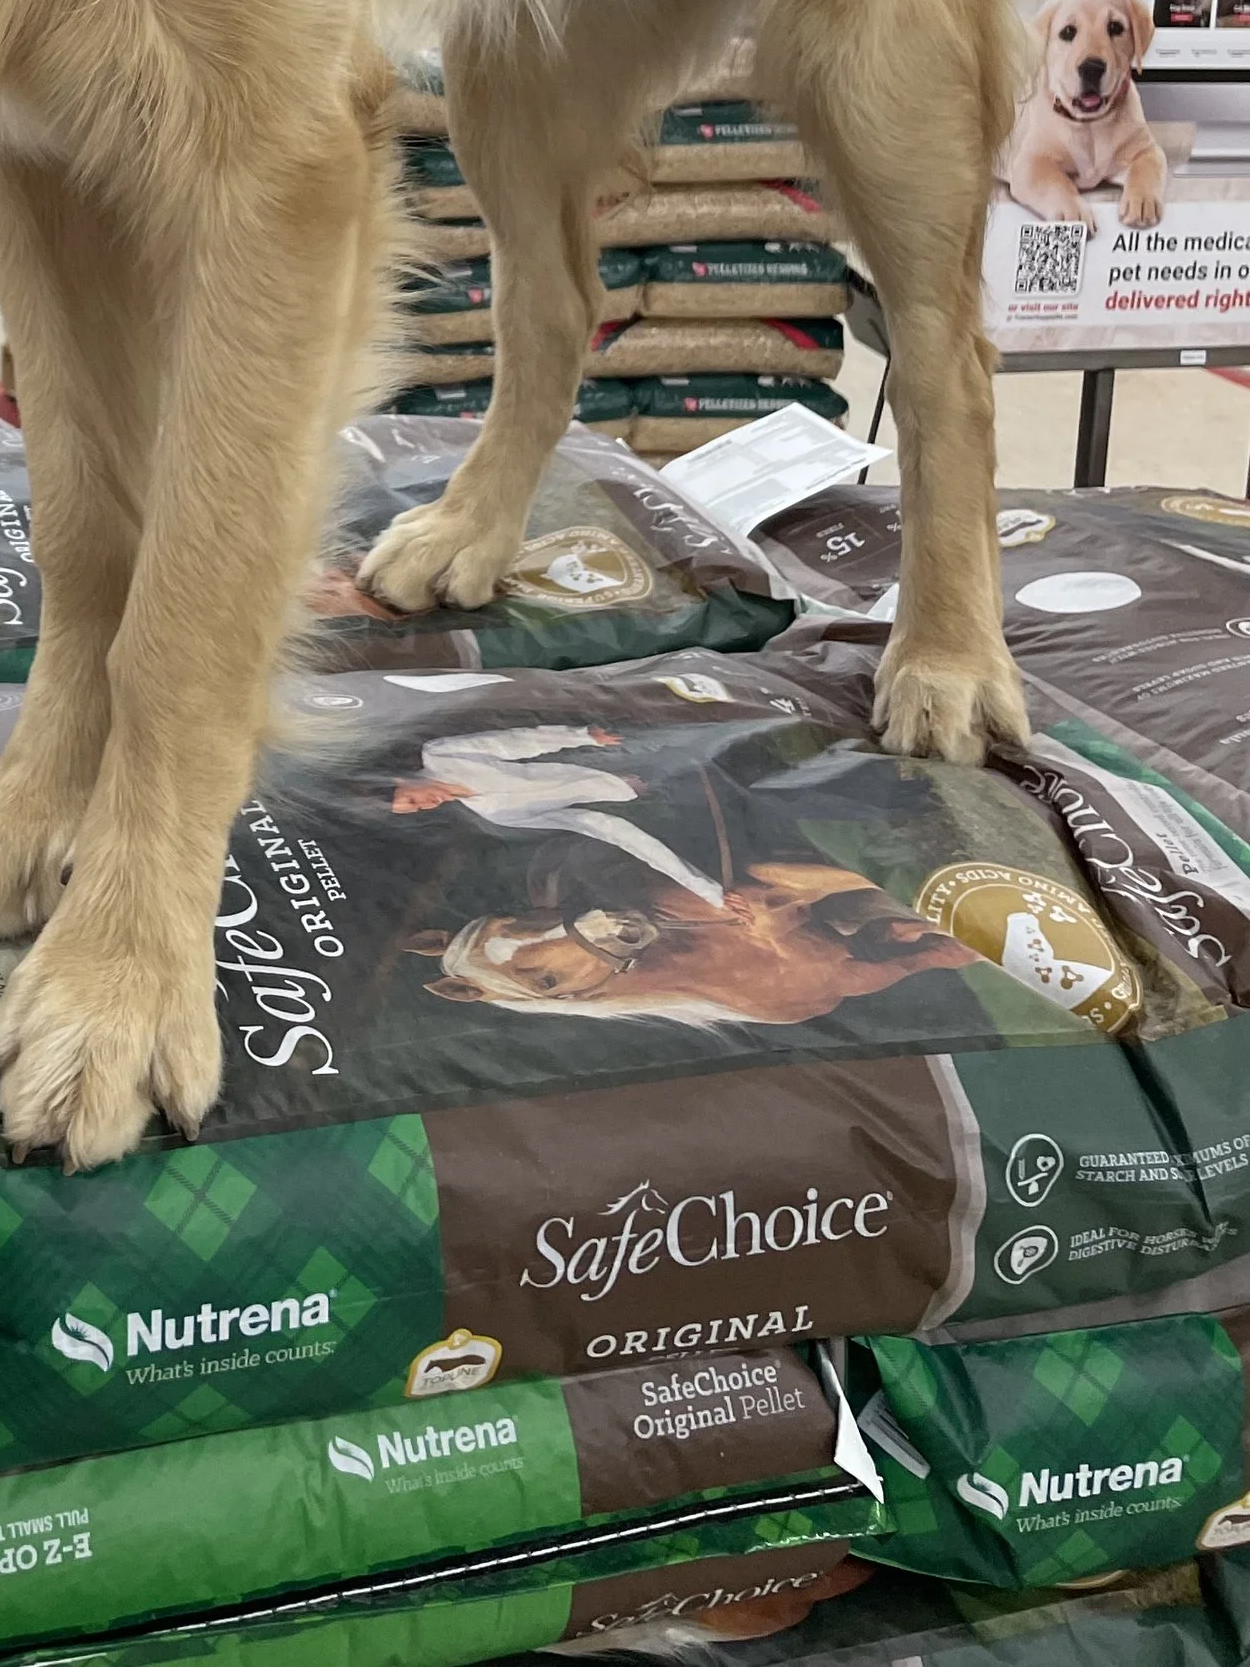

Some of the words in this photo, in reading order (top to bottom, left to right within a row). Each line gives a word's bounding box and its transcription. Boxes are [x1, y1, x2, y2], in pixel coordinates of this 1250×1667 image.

[1111, 231, 1140, 253] All
[1146, 232, 1178, 252] the
[1108, 263, 1141, 287] pet
[1147, 260, 1208, 281] needs
[1213, 260, 1232, 279] in
[1104, 289, 1200, 311] delivered
[820, 530, 866, 564] 15%
[297, 837, 347, 902] PELLET
[1155, 831, 1200, 877] Pellet
[241, 799, 345, 958] ORIGINAL
[955, 868, 1013, 885] ACIDS
[1017, 875, 1090, 916] AMINO
[214, 854, 340, 1076] SafeC
[1074, 1170, 1136, 1183] STARCH
[1138, 1168, 1169, 1182] AND
[1199, 1153, 1250, 1181] LEVELS
[1078, 1150, 1170, 1169] GUARANTEED
[520, 1186, 891, 1301] SafeChoice
[1067, 1239, 1137, 1262] DIGESTIVE
[1069, 1227, 1107, 1248] IDEAL
[1108, 1226, 1140, 1240] FOR
[126, 1291, 331, 1358] Nutrena
[586, 1305, 814, 1359] ORIGINAL
[125, 1359, 194, 1386] What's
[199, 1348, 261, 1378] inside
[422, 1366, 481, 1386] TOPLINE
[641, 1358, 778, 1408] SafeChoice
[633, 1397, 736, 1440] Original
[740, 1385, 806, 1422] Pellet
[377, 1417, 518, 1470] Nutrena
[387, 1472, 431, 1495] What's
[434, 1464, 478, 1487] inside
[1018, 1456, 1184, 1507] Nutrena
[9, 1512, 53, 1537] SMALL
[55, 1507, 90, 1528] PULL
[1016, 1511, 1072, 1535] What's
[1075, 1504, 1120, 1527] inside
[45, 1531, 92, 1565] E-Z
